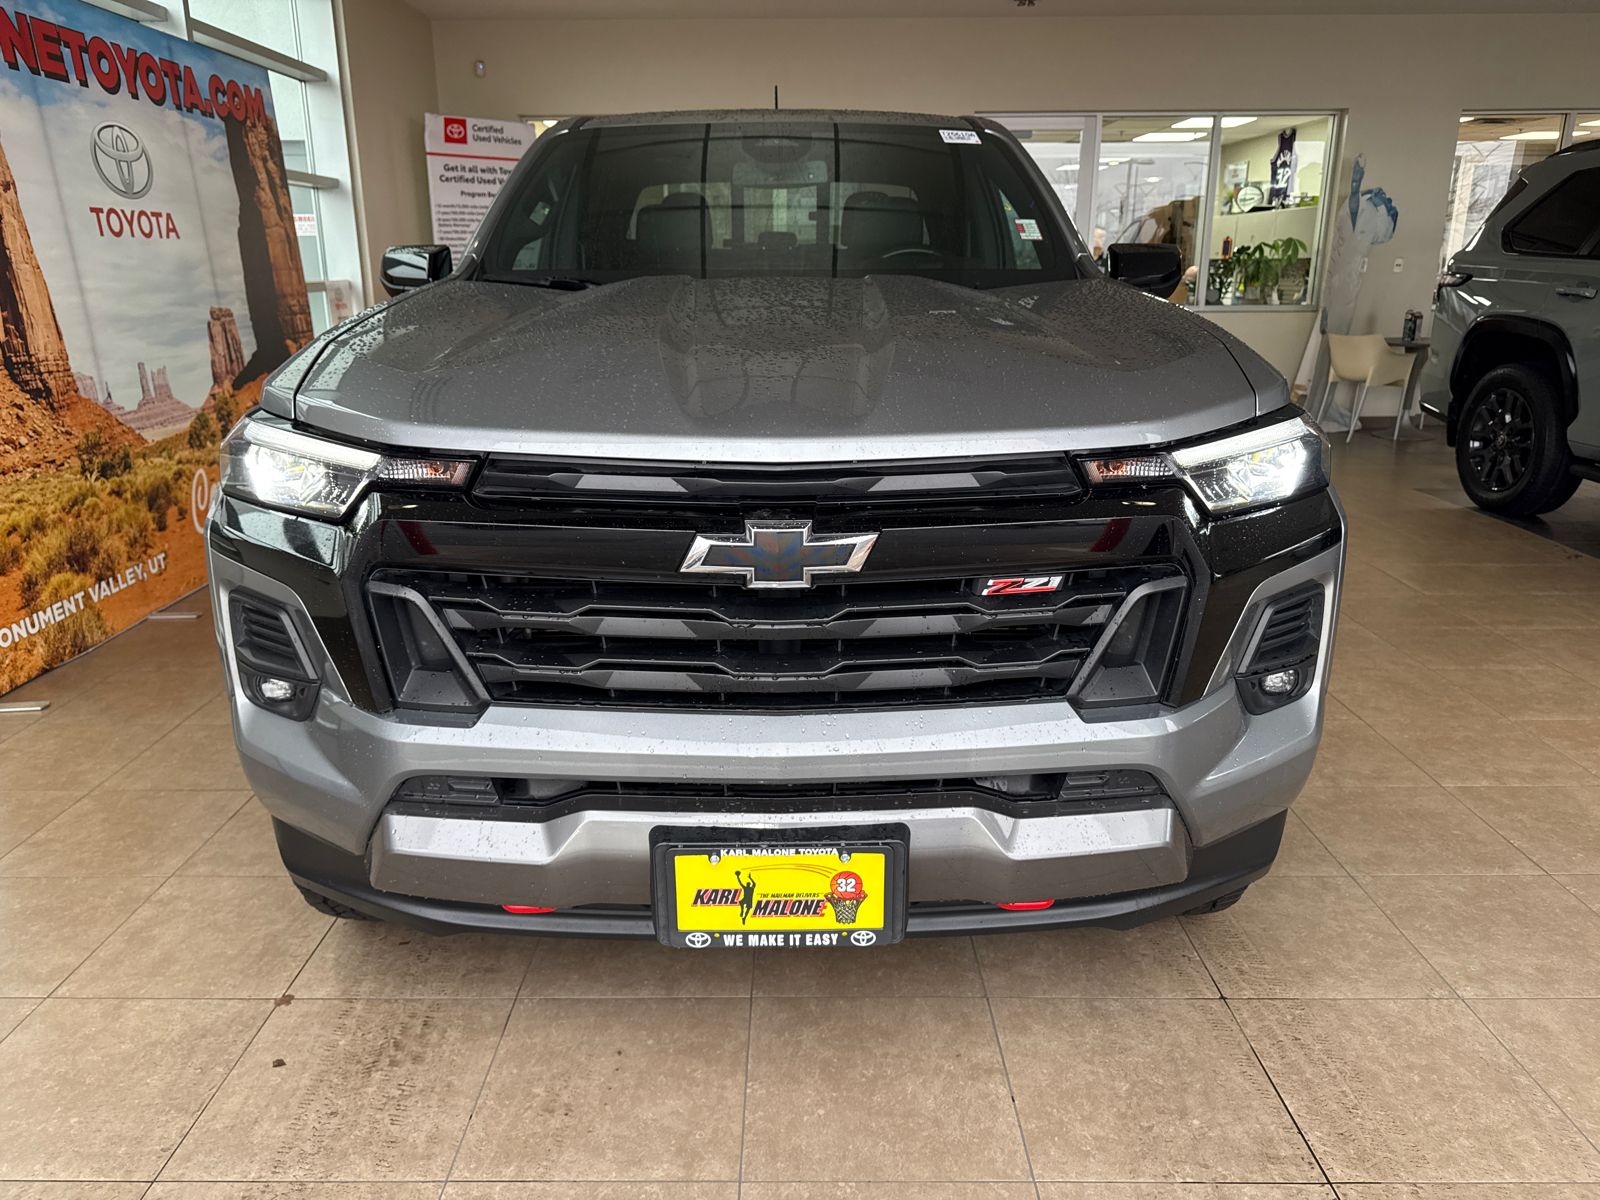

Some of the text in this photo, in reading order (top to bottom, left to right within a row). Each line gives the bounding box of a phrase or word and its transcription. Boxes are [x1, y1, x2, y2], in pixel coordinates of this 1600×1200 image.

[472, 123, 504, 134] Certified
[472, 133, 522, 146] Used Vehicles
[443, 163, 459, 173] Get
[460, 164, 466, 173] it
[468, 165, 478, 174] all
[480, 166, 498, 175] with
[439, 174, 475, 184] Certified
[476, 176, 497, 185] Used
[1275, 167, 1292, 189] 32
[460, 190, 486, 199] Program
[89, 207, 180, 239] TOYOTA
[88, 562, 148, 604] VALLEY,
[147, 553, 167, 575] UT
[720, 848, 839, 857] KARL MALONE TOYOTA
[837, 878, 856, 893] 32
[692, 888, 742, 906] KARL
[752, 898, 827, 917] MALONE
[723, 933, 838, 947] WE MAKE IT EASY
